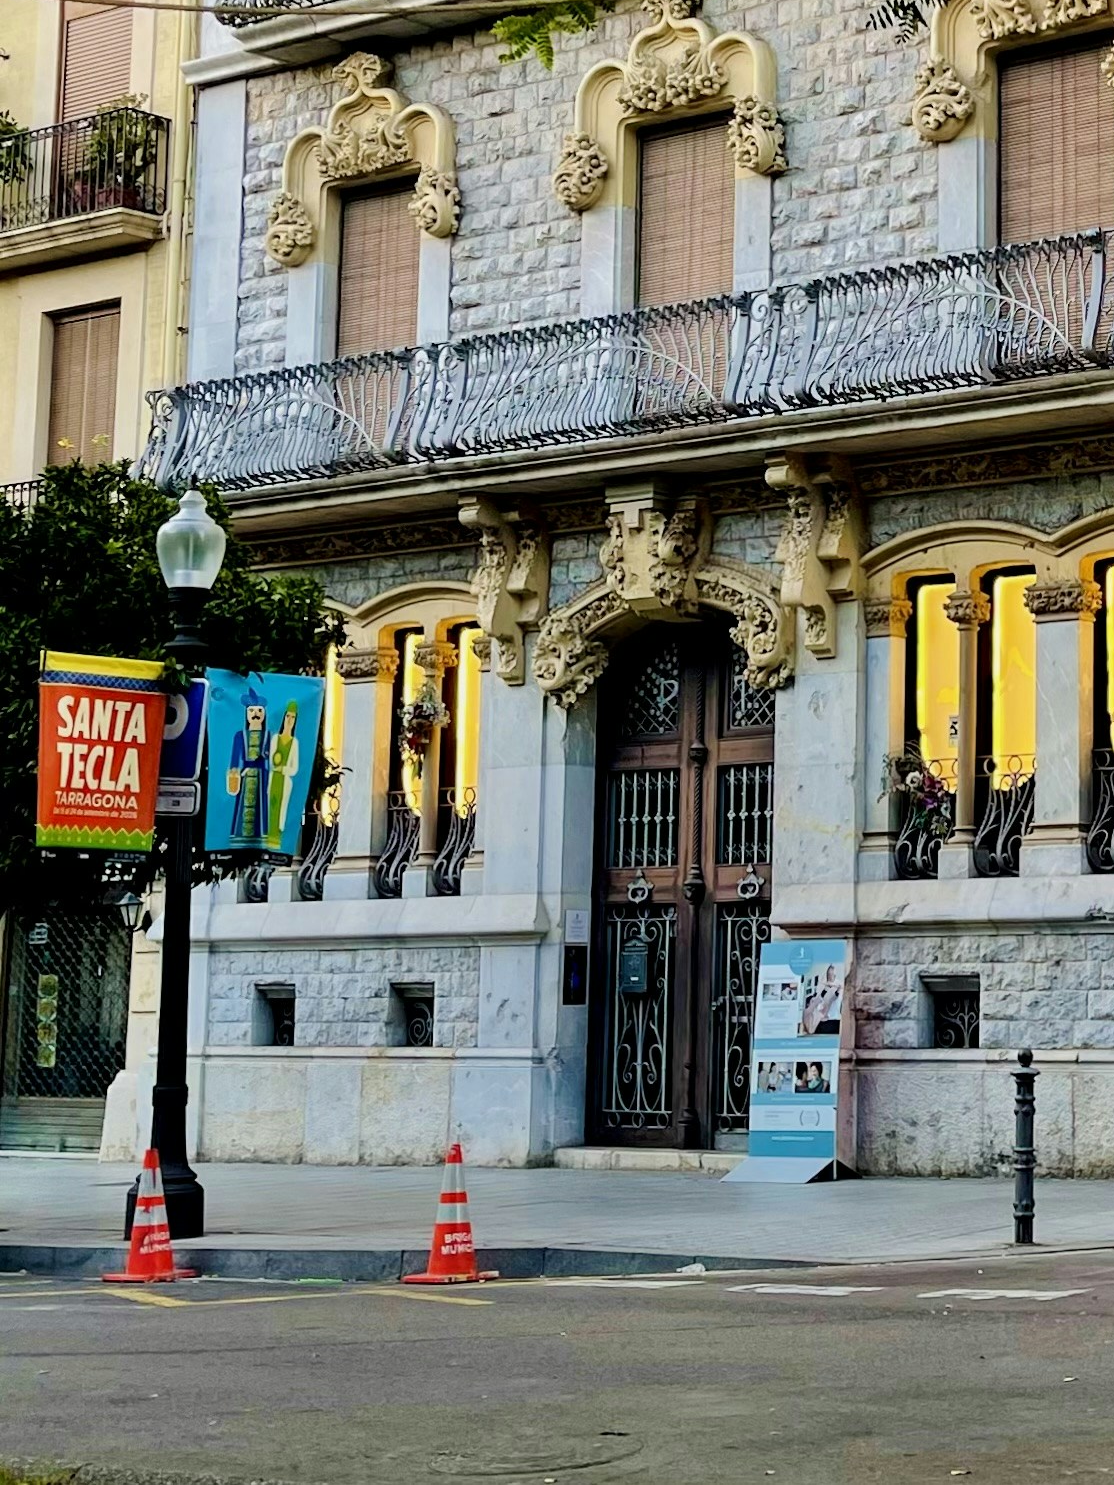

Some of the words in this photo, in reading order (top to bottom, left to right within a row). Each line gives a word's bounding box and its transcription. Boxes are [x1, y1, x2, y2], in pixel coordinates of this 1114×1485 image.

[57, 695, 146, 744] SANTA
[56, 742, 140, 793] TECLA
[55, 790, 138, 809] TARRAGONA
